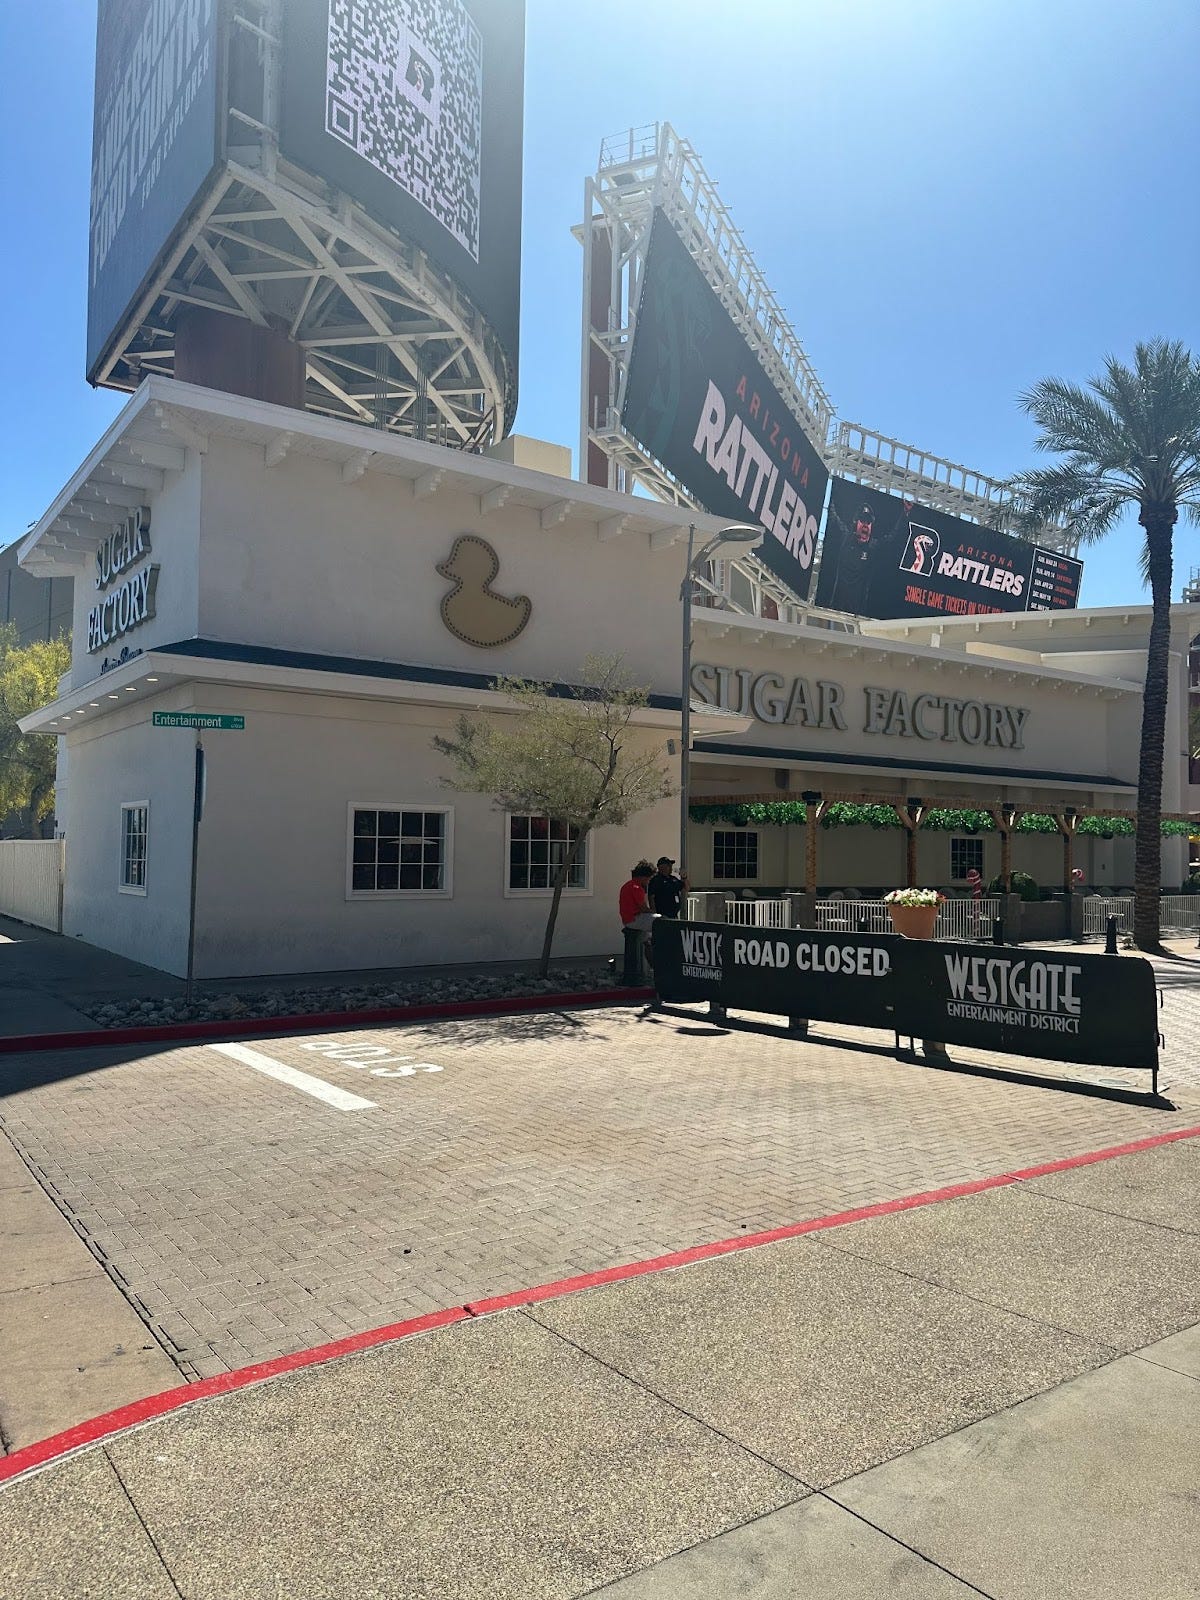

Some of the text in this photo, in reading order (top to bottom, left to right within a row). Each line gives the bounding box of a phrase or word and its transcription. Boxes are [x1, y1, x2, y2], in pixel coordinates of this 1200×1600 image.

[93, 143, 128, 288] FORD
[736, 374, 810, 488] ARIZONA
[693, 379, 818, 570] RATTLERS
[95, 505, 152, 590] SUGAR
[937, 551, 1025, 597] RATTLERS
[957, 544, 1014, 569] ARIZONA
[86, 562, 160, 655] FACTORY
[905, 585, 928, 605] SINGLE
[926, 591, 945, 610] GAME
[944, 595, 967, 614] TICKETS
[154, 713, 222, 728] Entertainment
[690, 663, 1032, 750] SUGAR FACTORY
[734, 938, 890, 977] ROAD CLOSED
[944, 951, 1082, 1015] WESTGATE
[947, 1002, 1080, 1034] ENTERTAINMENT DISTRICT
[298, 1040, 444, 1078] STOP
